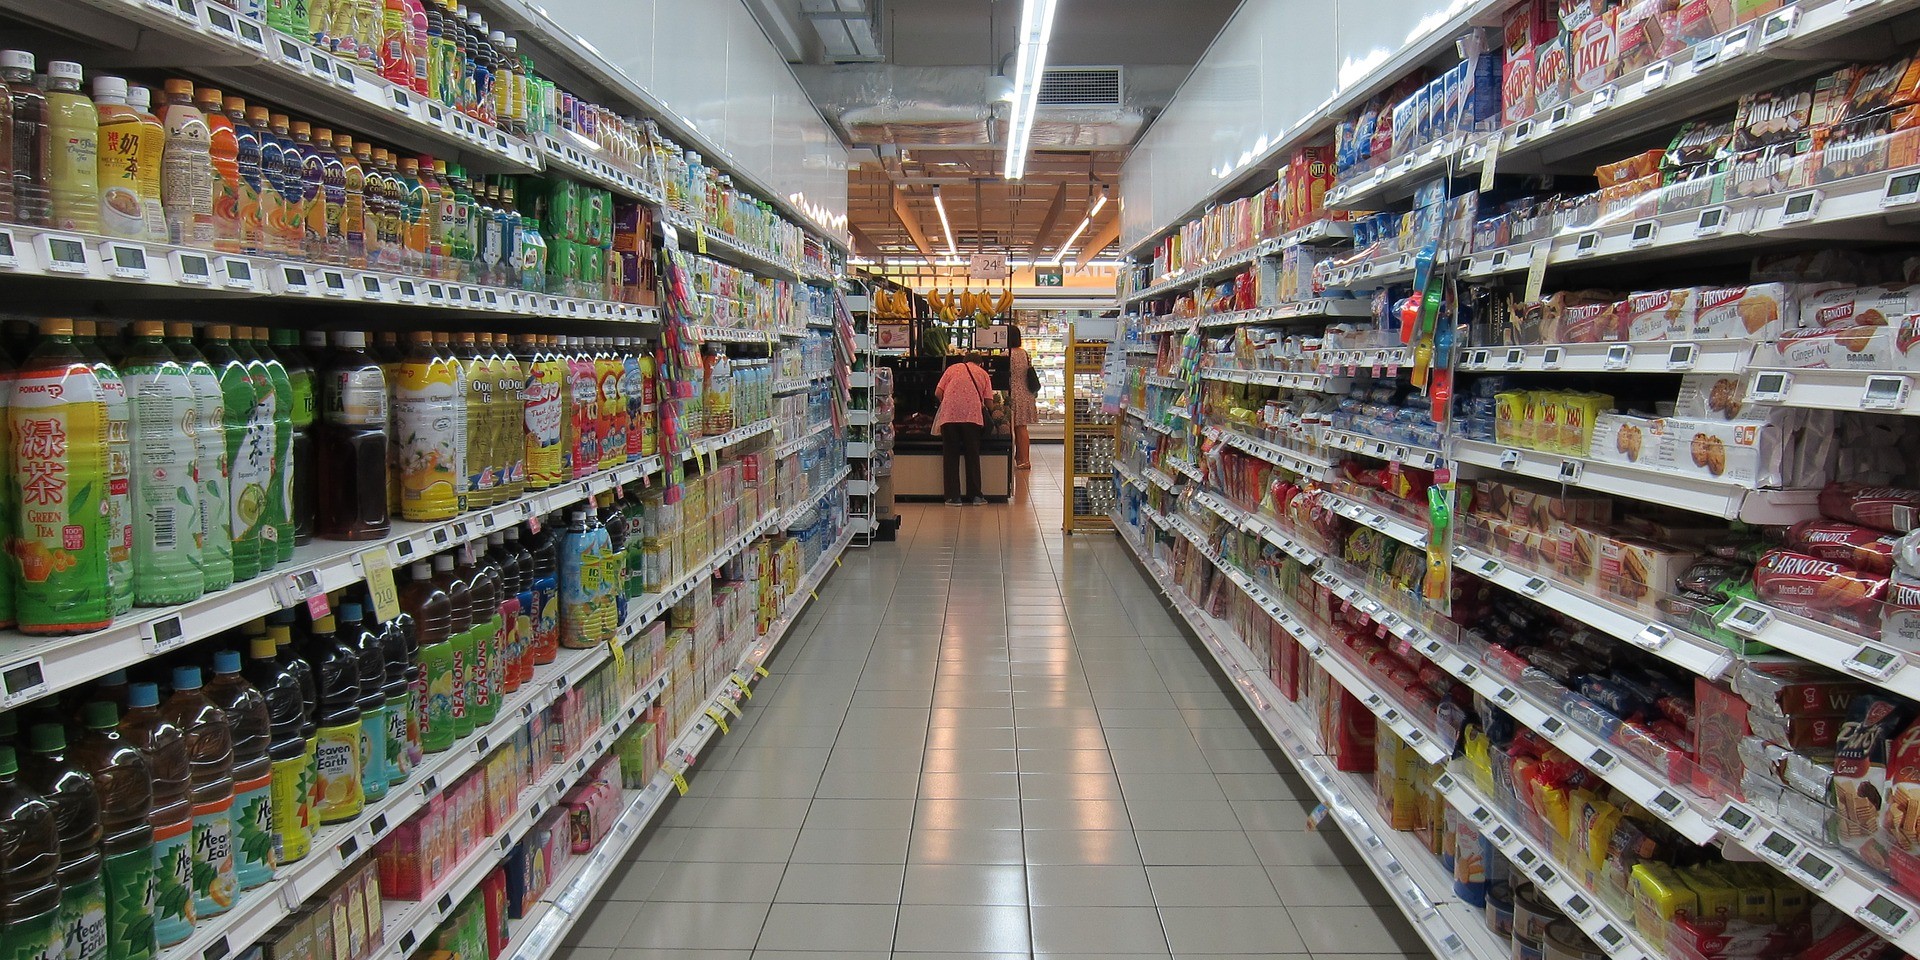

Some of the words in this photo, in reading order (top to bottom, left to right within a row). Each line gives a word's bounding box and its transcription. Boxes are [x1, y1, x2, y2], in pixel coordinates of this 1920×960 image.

[1579, 35, 1610, 79] JATZ
[1395, 104, 1413, 138] OREO
[118, 132, 139, 180] 奶茶
[1310, 163, 1326, 174] RITZ
[1064, 265, 1119, 277] DAIL
[1791, 347, 1815, 363] Ginger
[1816, 344, 1832, 355] Nut
[28, 510, 61, 523] GREEN
[35, 524, 54, 538] TEA
[1779, 585, 1797, 595] Monte
[1797, 586, 1814, 596] Carlo
[477, 639, 490, 708] SEASONS
[453, 650, 466, 720] SEASONS
[317, 757, 348, 771] Earth
